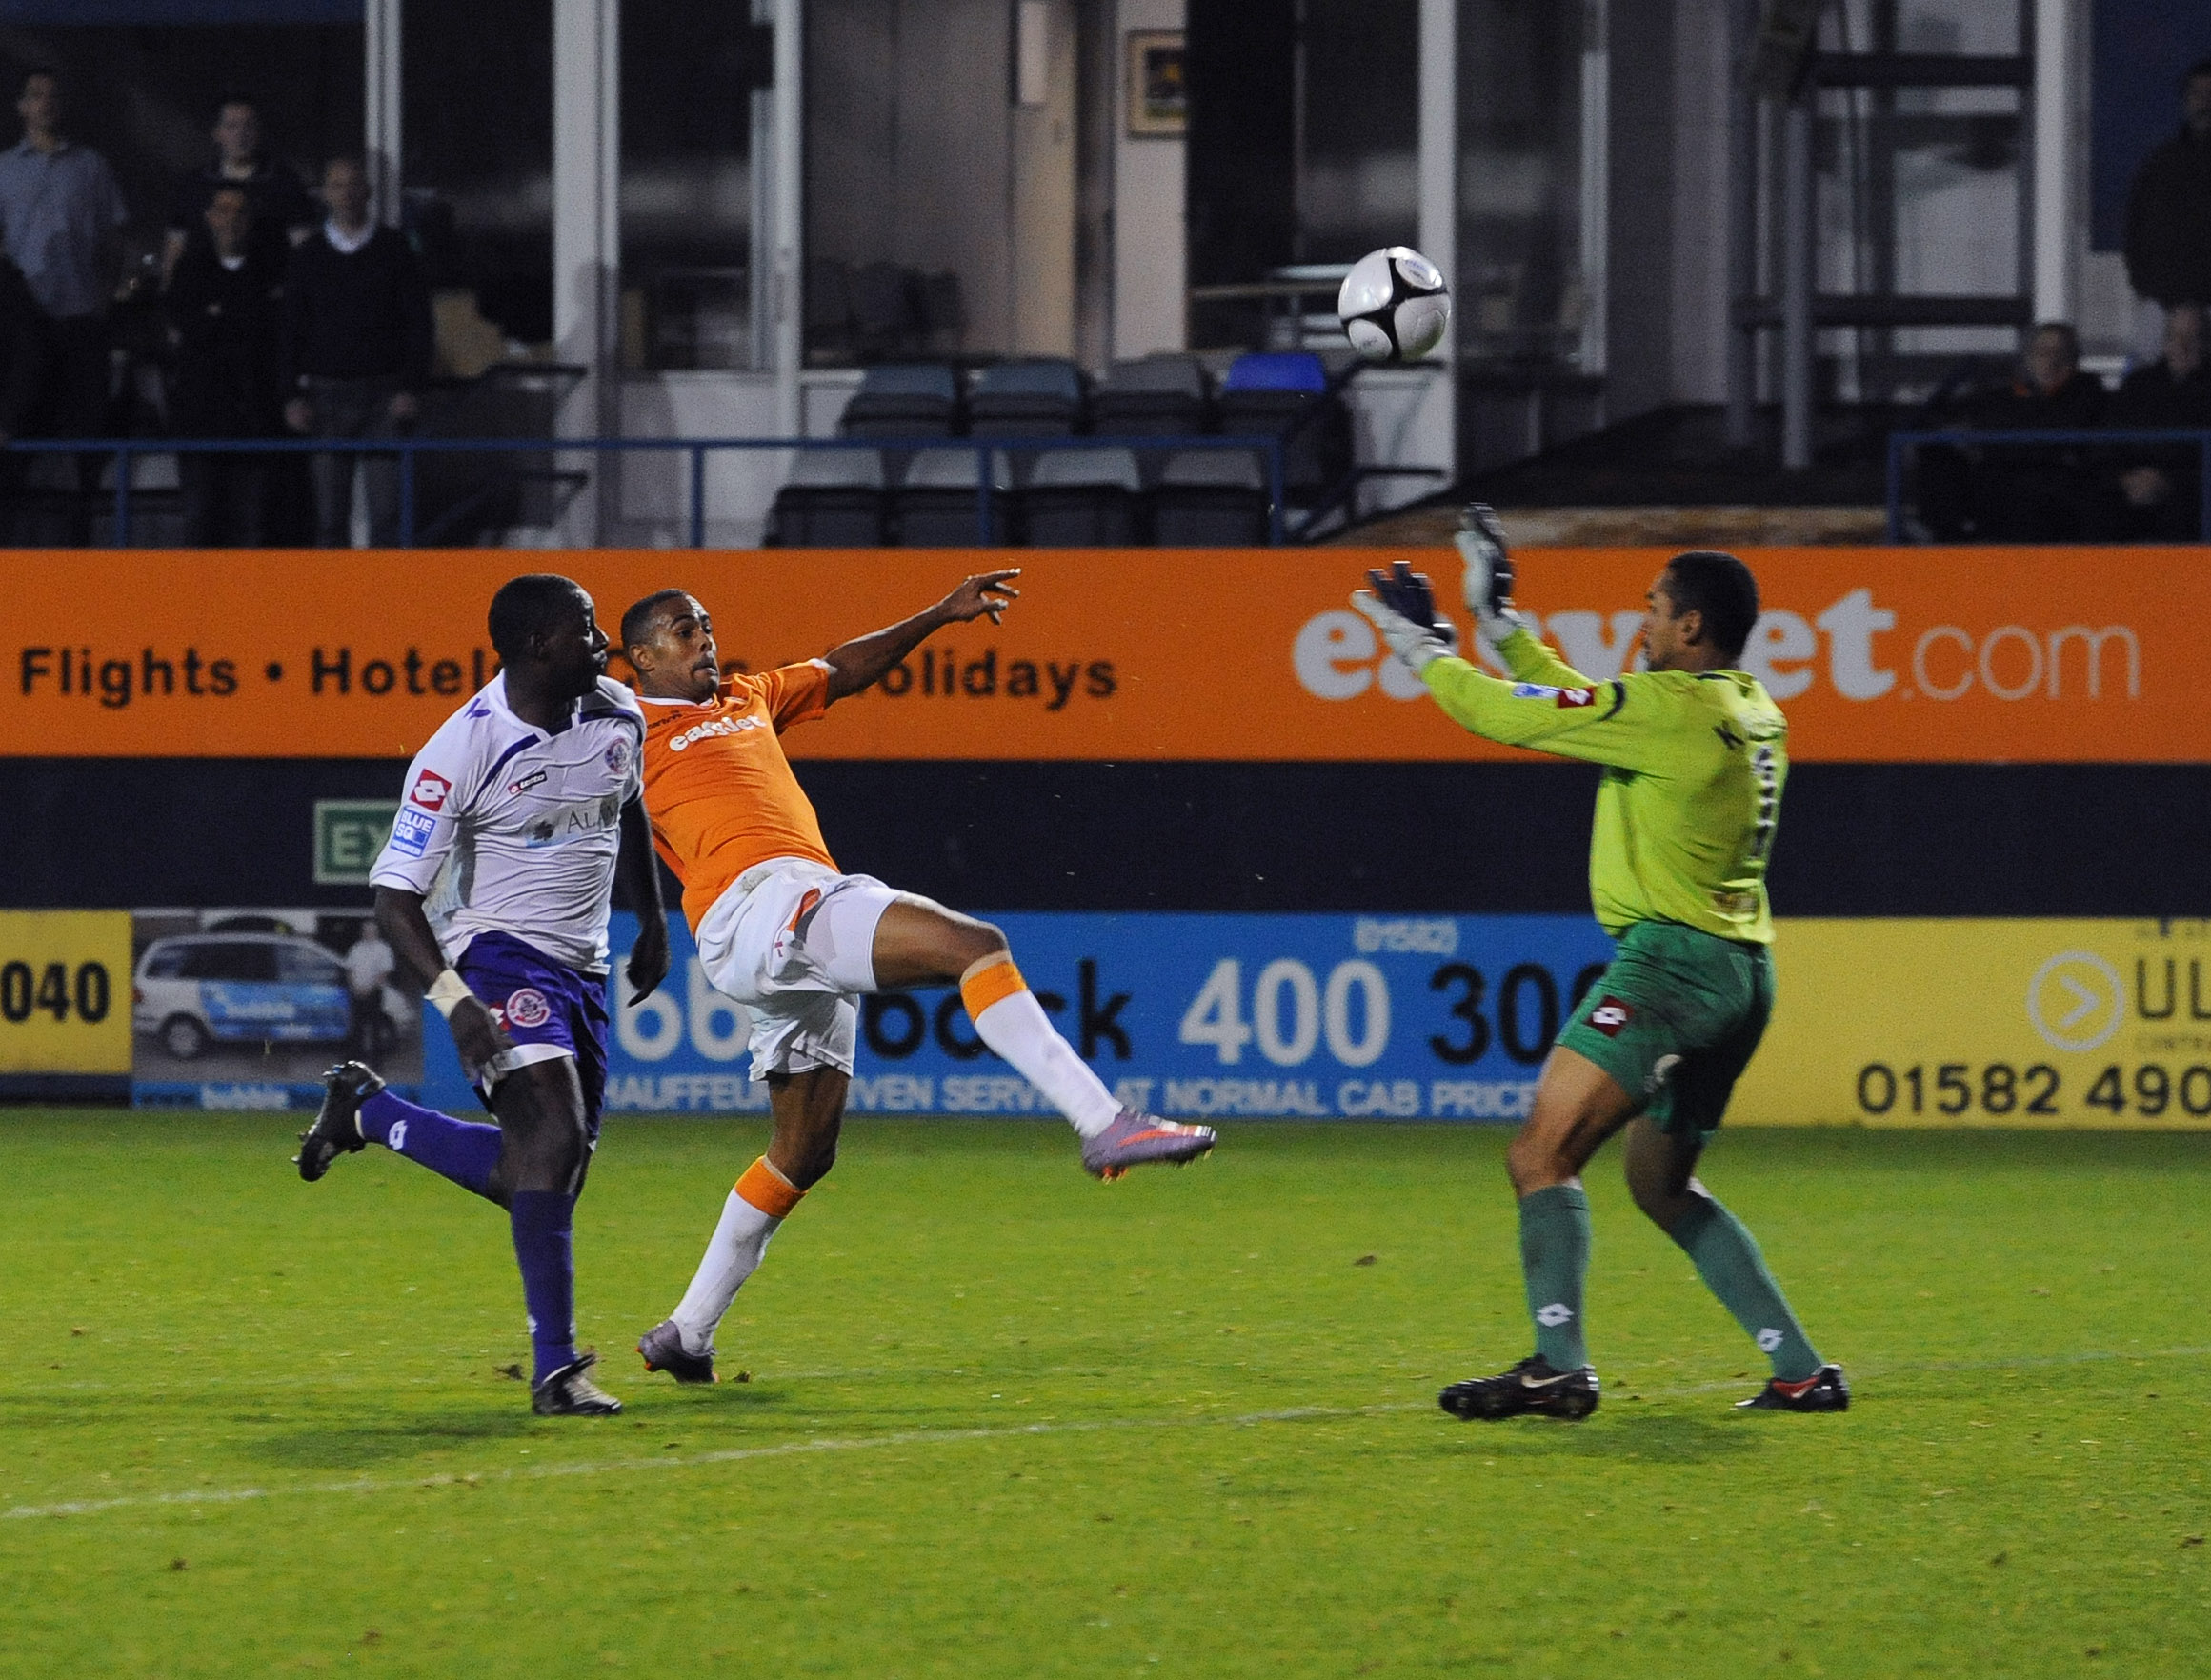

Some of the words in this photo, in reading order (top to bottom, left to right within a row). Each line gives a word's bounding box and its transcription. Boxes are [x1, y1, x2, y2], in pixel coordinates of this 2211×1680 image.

[21, 645, 238, 708] Flights
[311, 646, 500, 696] Hotel
[829, 646, 1118, 712] olidays
[332, 823, 392, 867] EX
[400, 810, 434, 834] BLUE
[1, 960, 110, 1024] 040
[1178, 958, 1390, 1068] 400
[1164, 1078, 1329, 1115] NORMAL
[1337, 1079, 1421, 1117] CAB
[1857, 1062, 2061, 1115] 01582
[2084, 1063, 2211, 1118] 490
